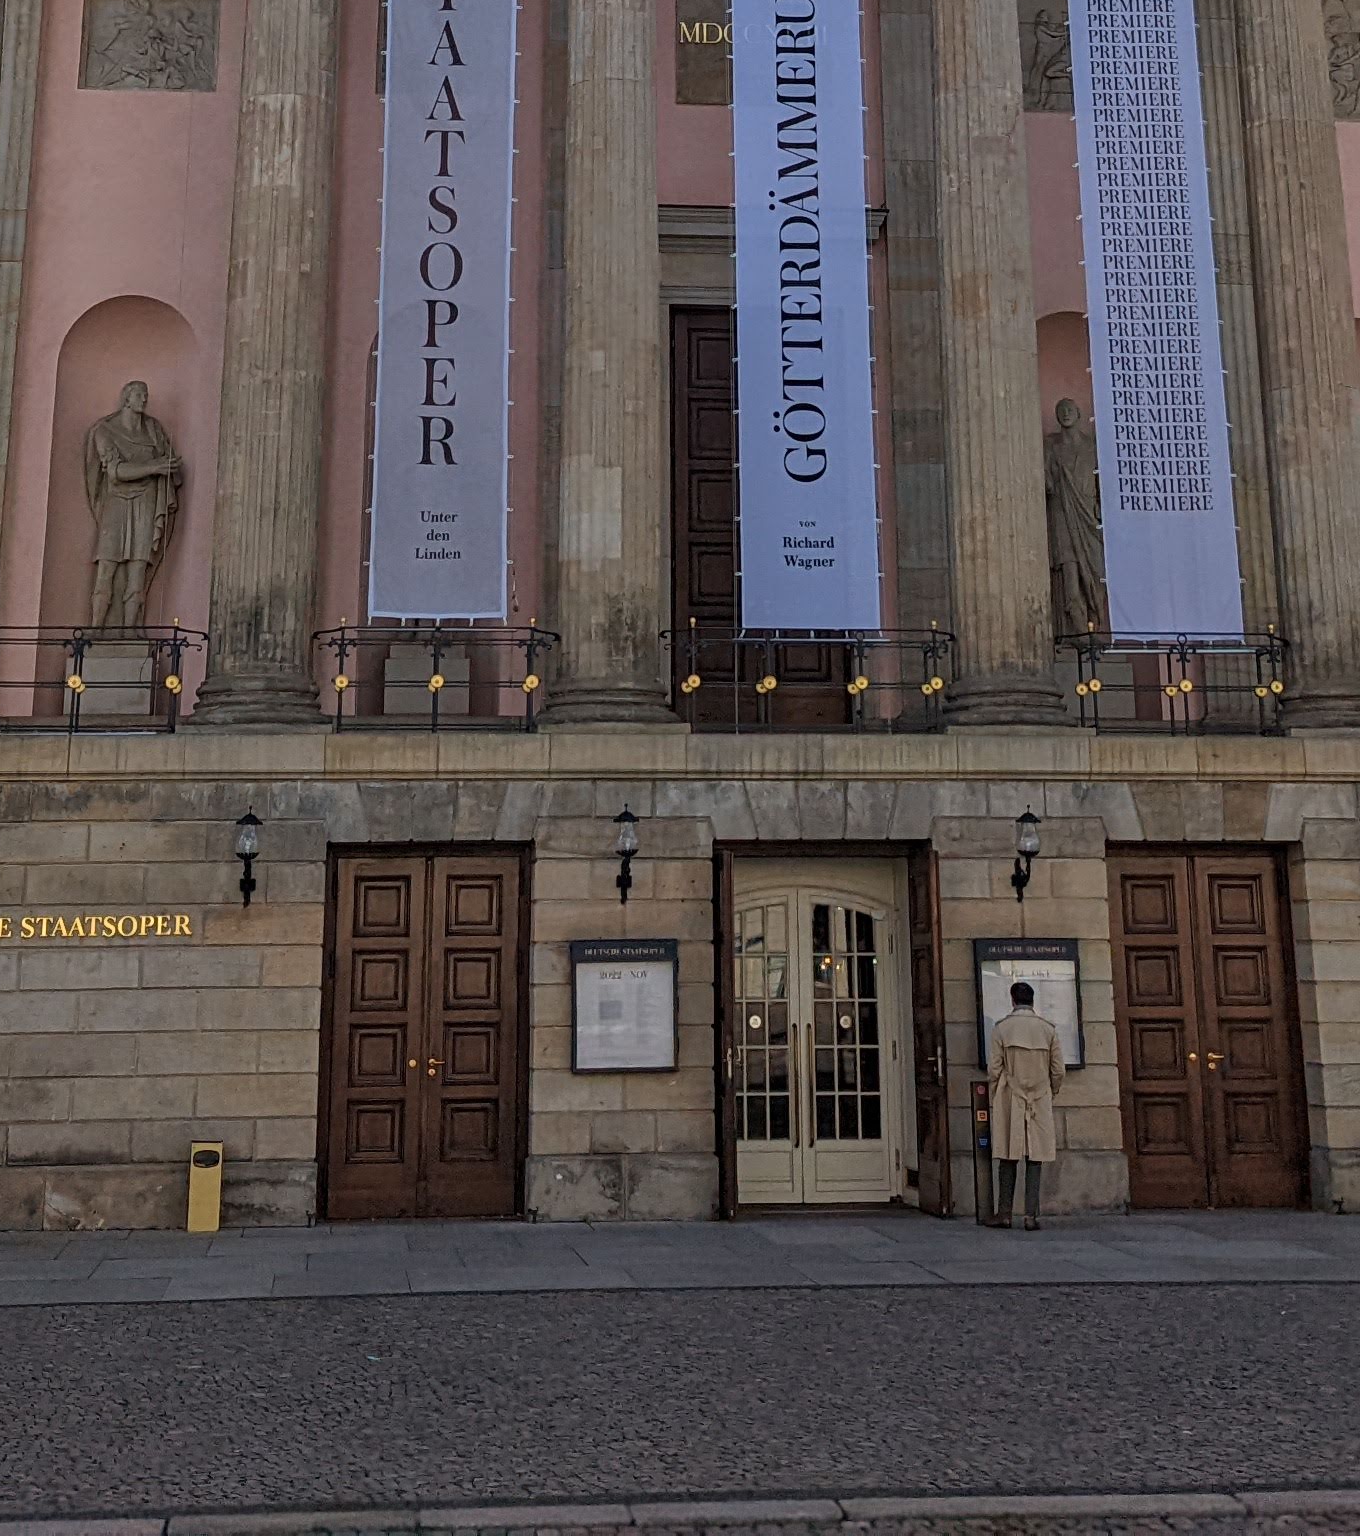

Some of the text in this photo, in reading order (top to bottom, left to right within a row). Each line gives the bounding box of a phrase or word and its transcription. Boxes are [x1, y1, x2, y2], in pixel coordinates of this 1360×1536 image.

[1087, 13, 1176, 28] PREMIERE
[1088, 29, 1177, 44] PREMIERE
[1089, 45, 1179, 60] PREMIERE
[1090, 60, 1180, 75] PREMIERE
[1091, 76, 1181, 91] PREMIERE
[1092, 92, 1182, 107] PREMIERE
[1093, 108, 1184, 123] PREMIERE
[1094, 124, 1185, 139] PREMIERE
[1095, 140, 1186, 155] PREMIERE
[1096, 156, 1188, 171] PREMIERE
[1097, 172, 1189, 187] PREMIERE
[1098, 188, 1189, 204] PREMIERE
[1099, 205, 1191, 220] PREMIERE
[1100, 221, 1193, 237] PREMIERE
[1102, 238, 1194, 253] PREMIERE
[1103, 254, 1195, 270] PREMIERE
[1104, 271, 1197, 286] PREMIERE
[1105, 288, 1198, 303] PREMIERE
[1106, 305, 1199, 320] PREMIERE
[1107, 321, 1200, 337] PREMIERE
[1108, 338, 1202, 354] PREMIERE
[1109, 355, 1203, 372] PREMIERE
[1110, 373, 1204, 389] PREMIERE
[1112, 390, 1206, 406] PREMIERE
[1113, 407, 1207, 423] PREMIERE
[1114, 424, 1208, 441] PREMIERE
[1116, 442, 1210, 458] PREMIERE
[1117, 459, 1211, 476] PREMIERE
[1118, 477, 1213, 494] PREMIERE
[1119, 495, 1214, 512] PREMIERE
[420, 510, 459, 523] Unter
[426, 528, 450, 541] den
[782, 536, 835, 549] Richard
[415, 547, 461, 560] Linden
[783, 554, 835, 571] Wagner
[20, 914, 193, 939] STAATSOPER
